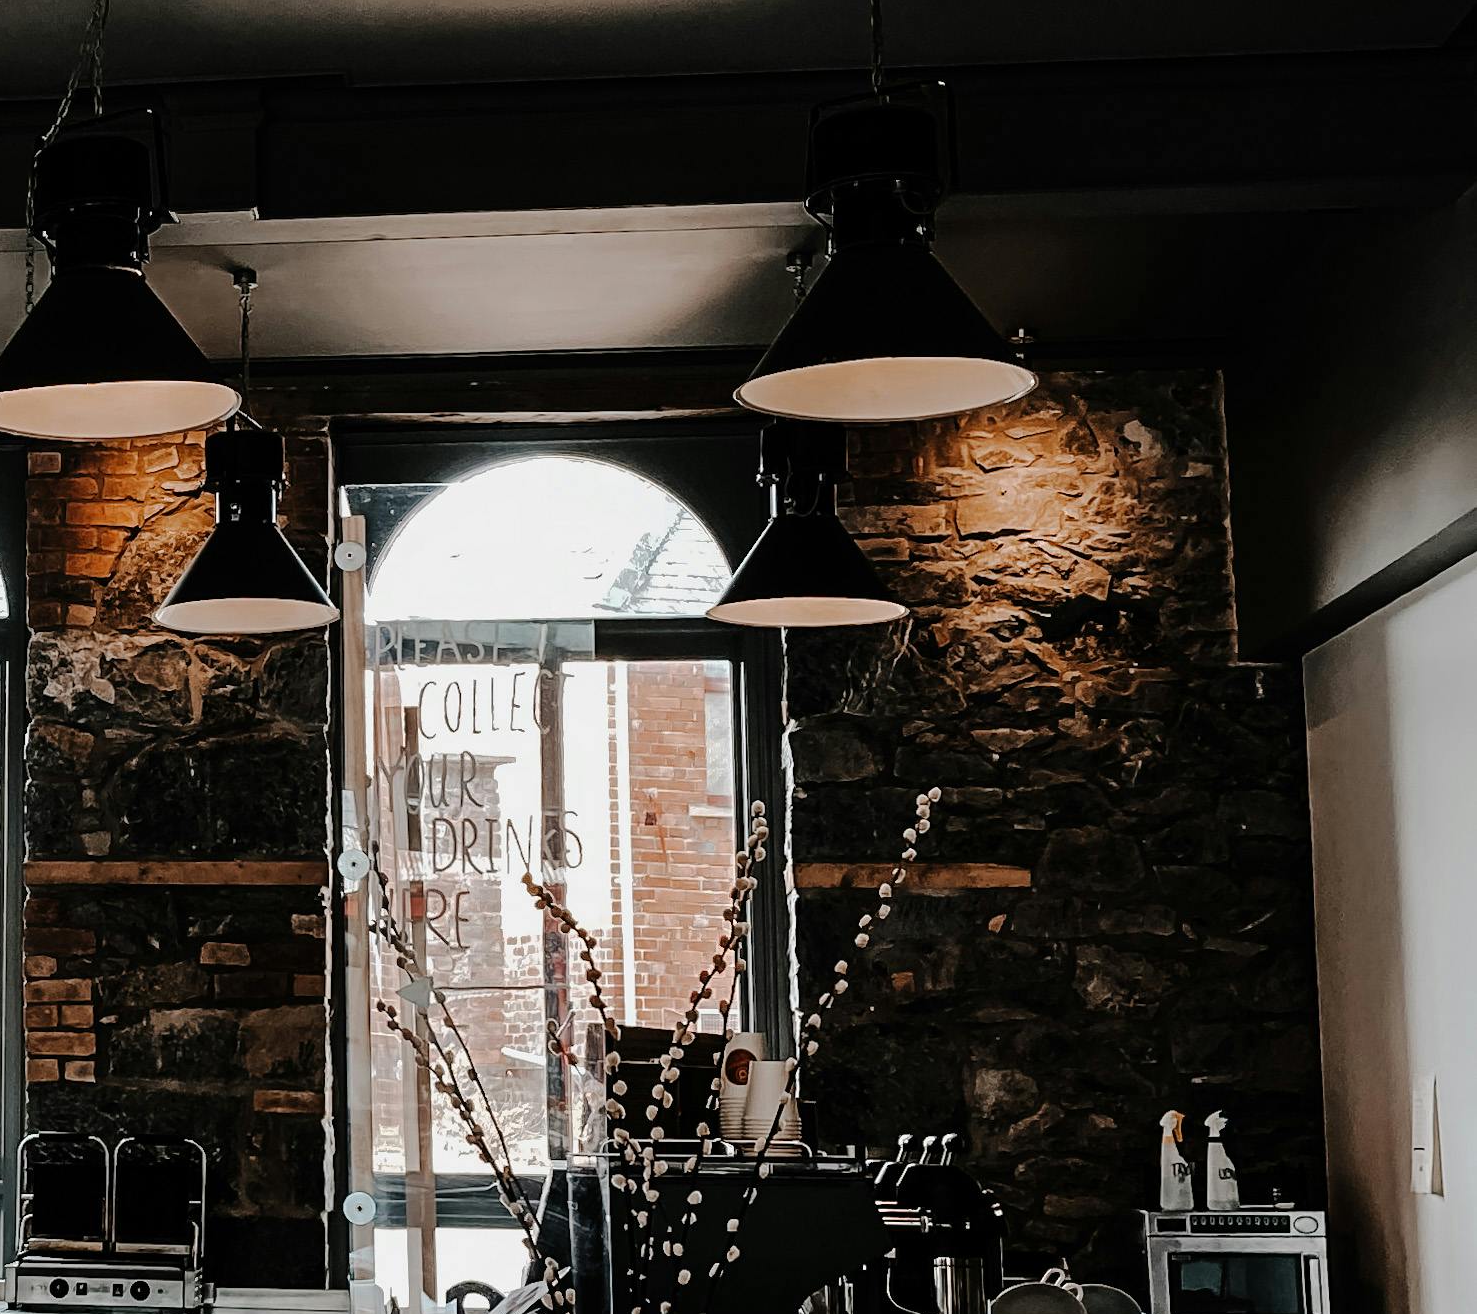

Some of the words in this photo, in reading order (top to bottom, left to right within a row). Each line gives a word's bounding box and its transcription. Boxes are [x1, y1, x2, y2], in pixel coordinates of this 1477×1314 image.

[375, 622, 510, 670] PLEASE
[418, 671, 575, 739] COLLECT
[377, 747, 484, 815] YOUR
[432, 810, 583, 875] DRINKS
[376, 887, 471, 950] HERE
